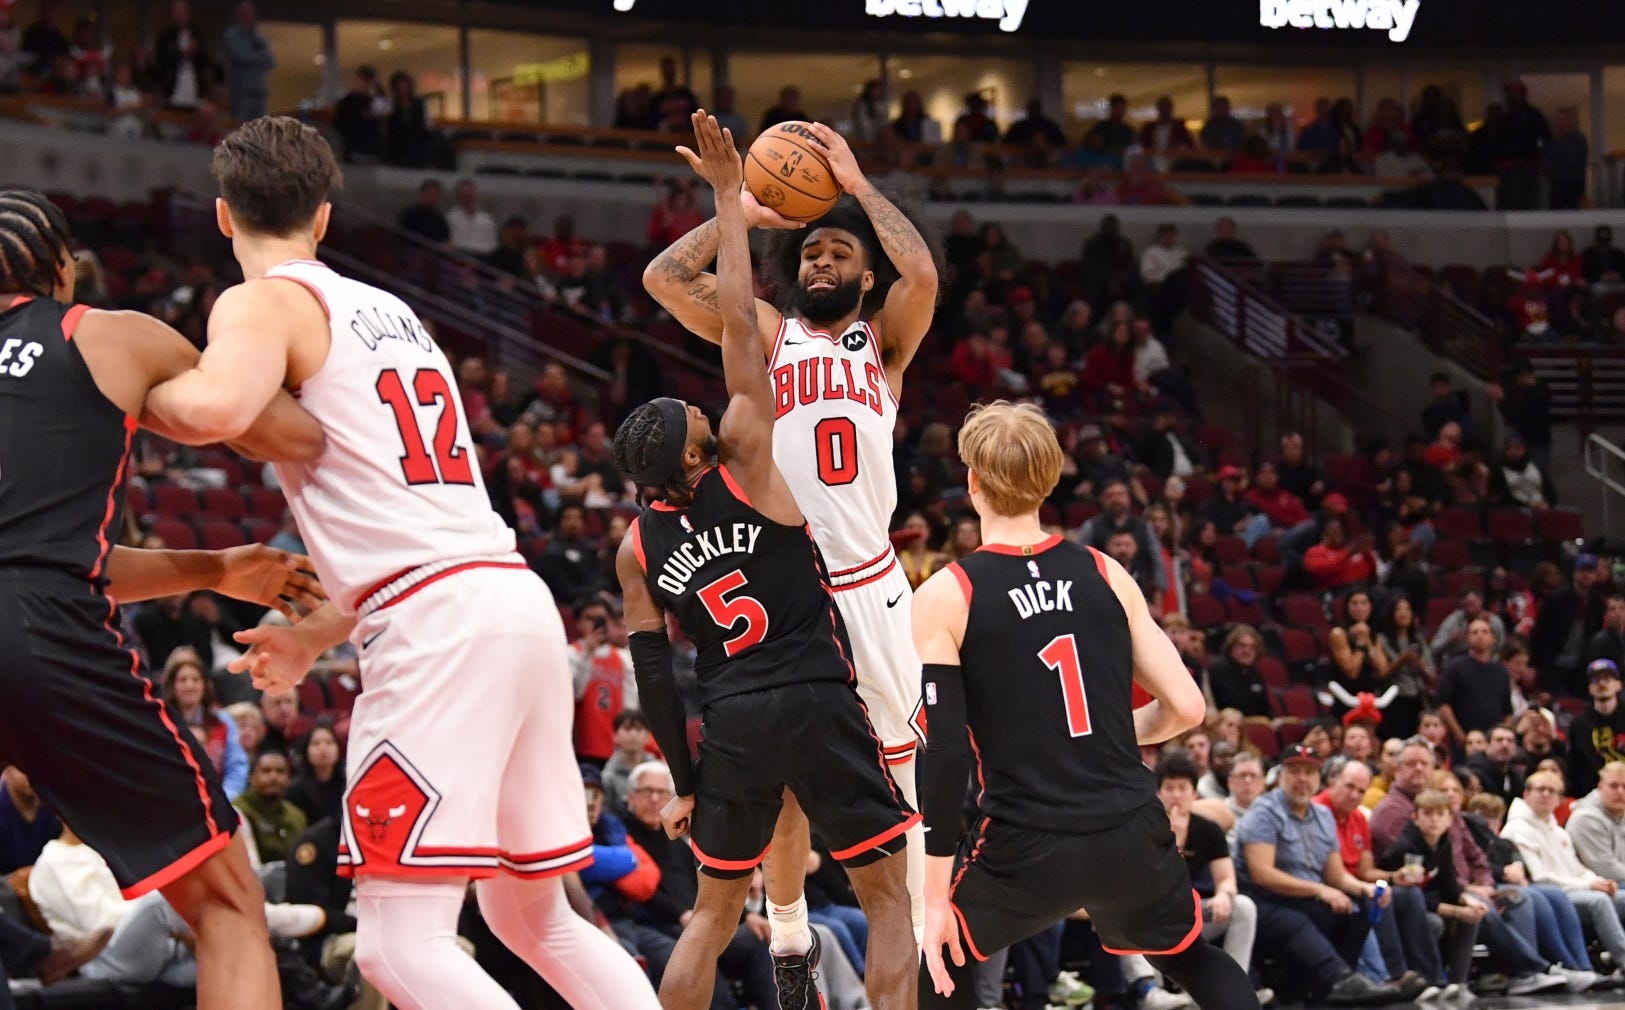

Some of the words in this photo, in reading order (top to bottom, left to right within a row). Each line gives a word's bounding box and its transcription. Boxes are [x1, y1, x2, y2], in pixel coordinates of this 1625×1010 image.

[1259, 0, 1421, 43] betway
[773, 356, 884, 421] BULLS
[375, 367, 476, 488] 12
[814, 416, 859, 487] 0
[657, 522, 763, 596] QUICKLEY
[695, 568, 769, 658] 5
[1007, 579, 1074, 620] DICK
[1036, 633, 1093, 738] 1
